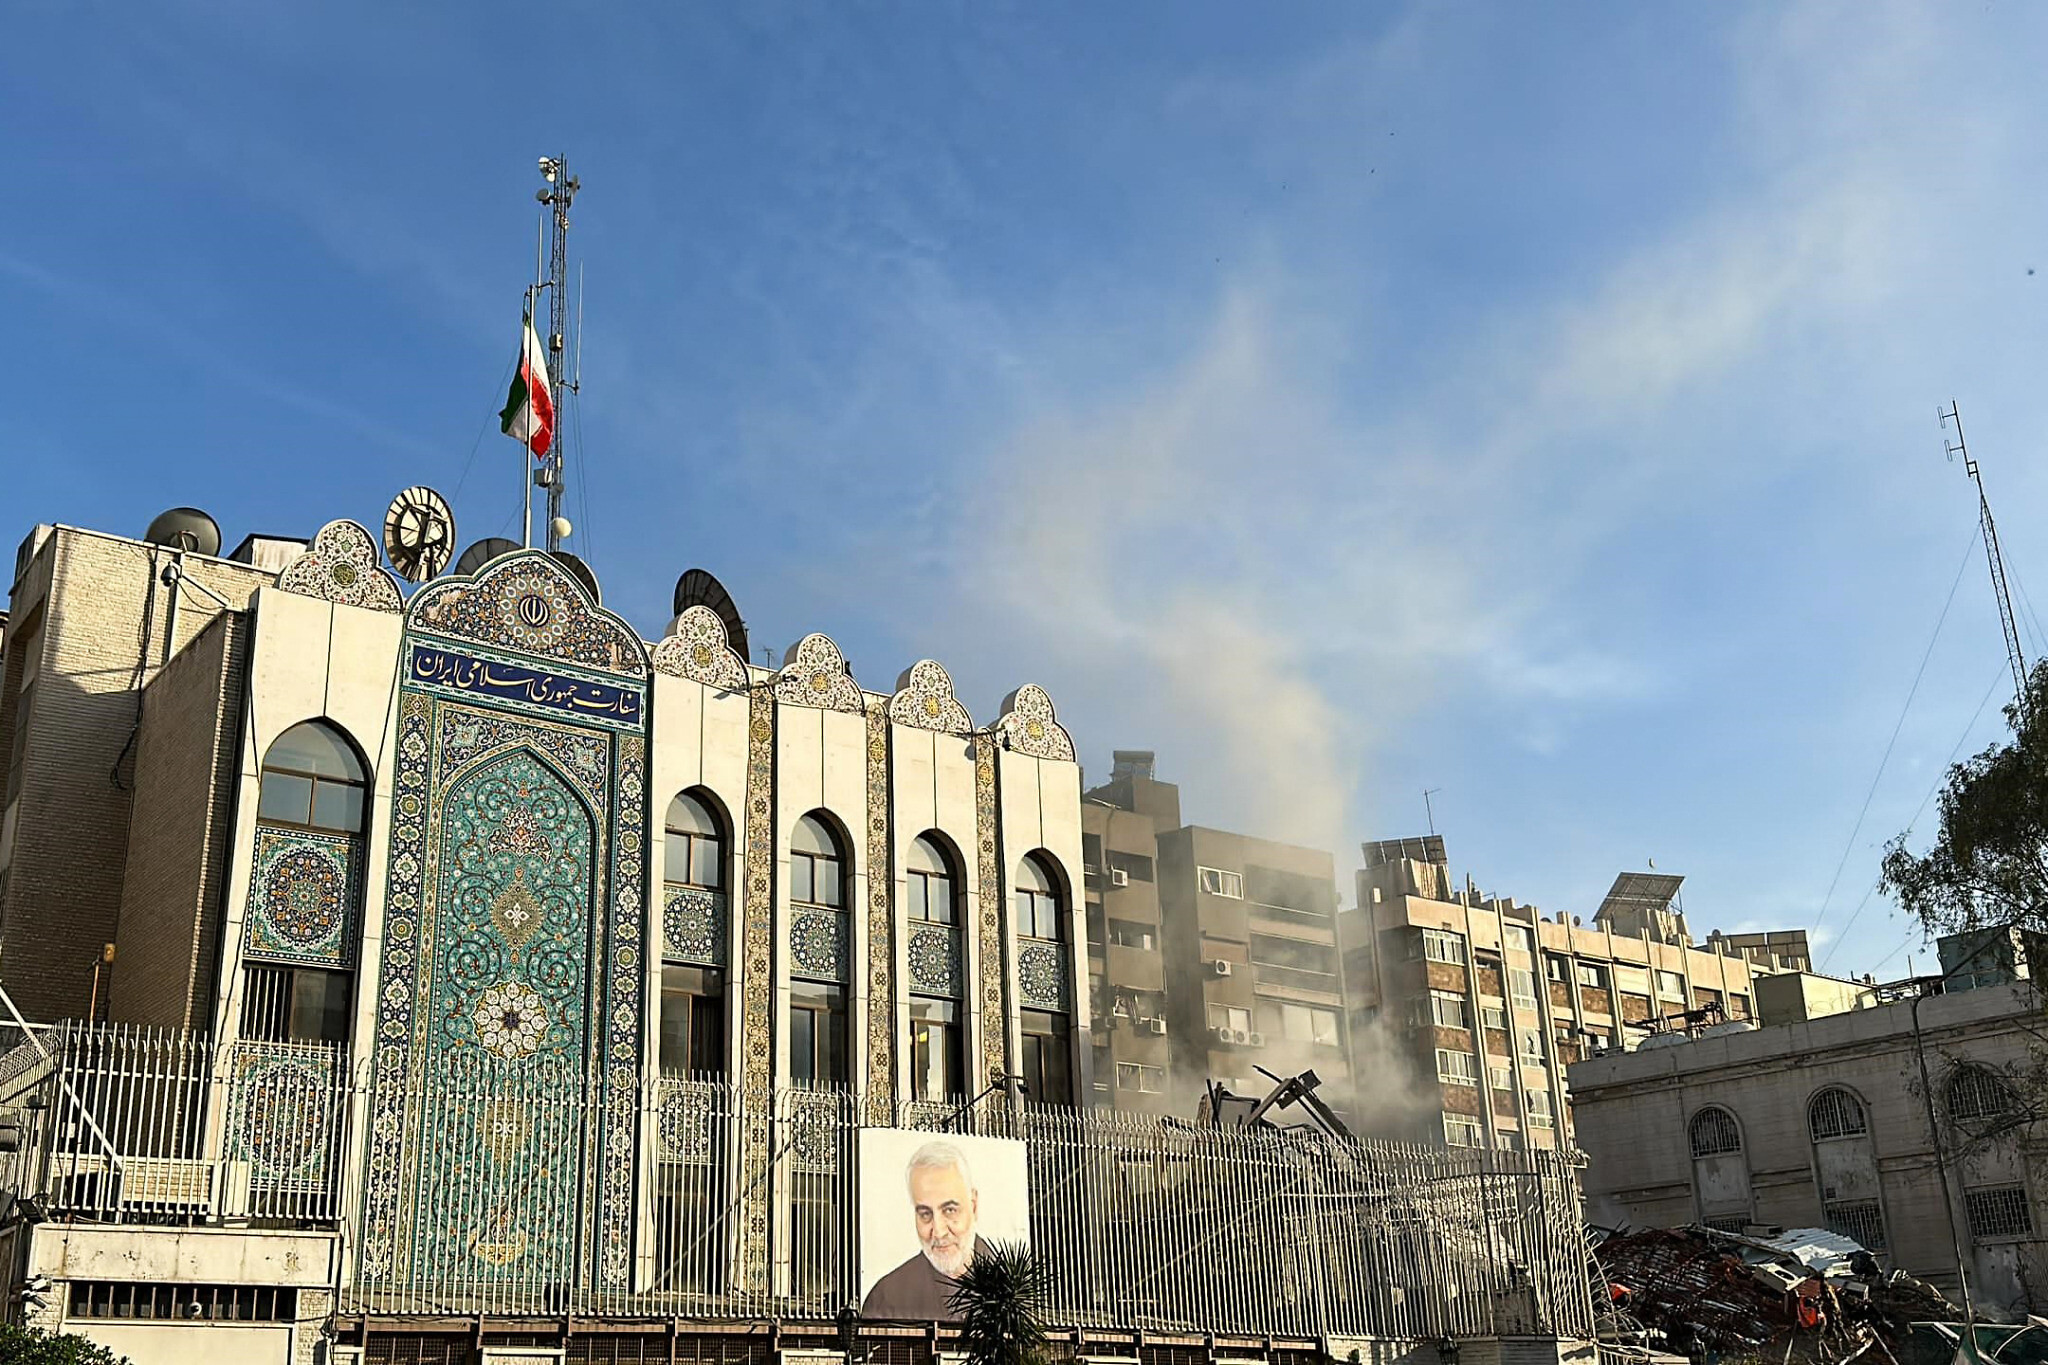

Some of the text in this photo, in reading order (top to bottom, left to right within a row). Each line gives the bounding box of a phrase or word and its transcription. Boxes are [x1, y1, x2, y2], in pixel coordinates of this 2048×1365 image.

[416, 654, 637, 715] سفارت جمهوری اسلامی ایران
